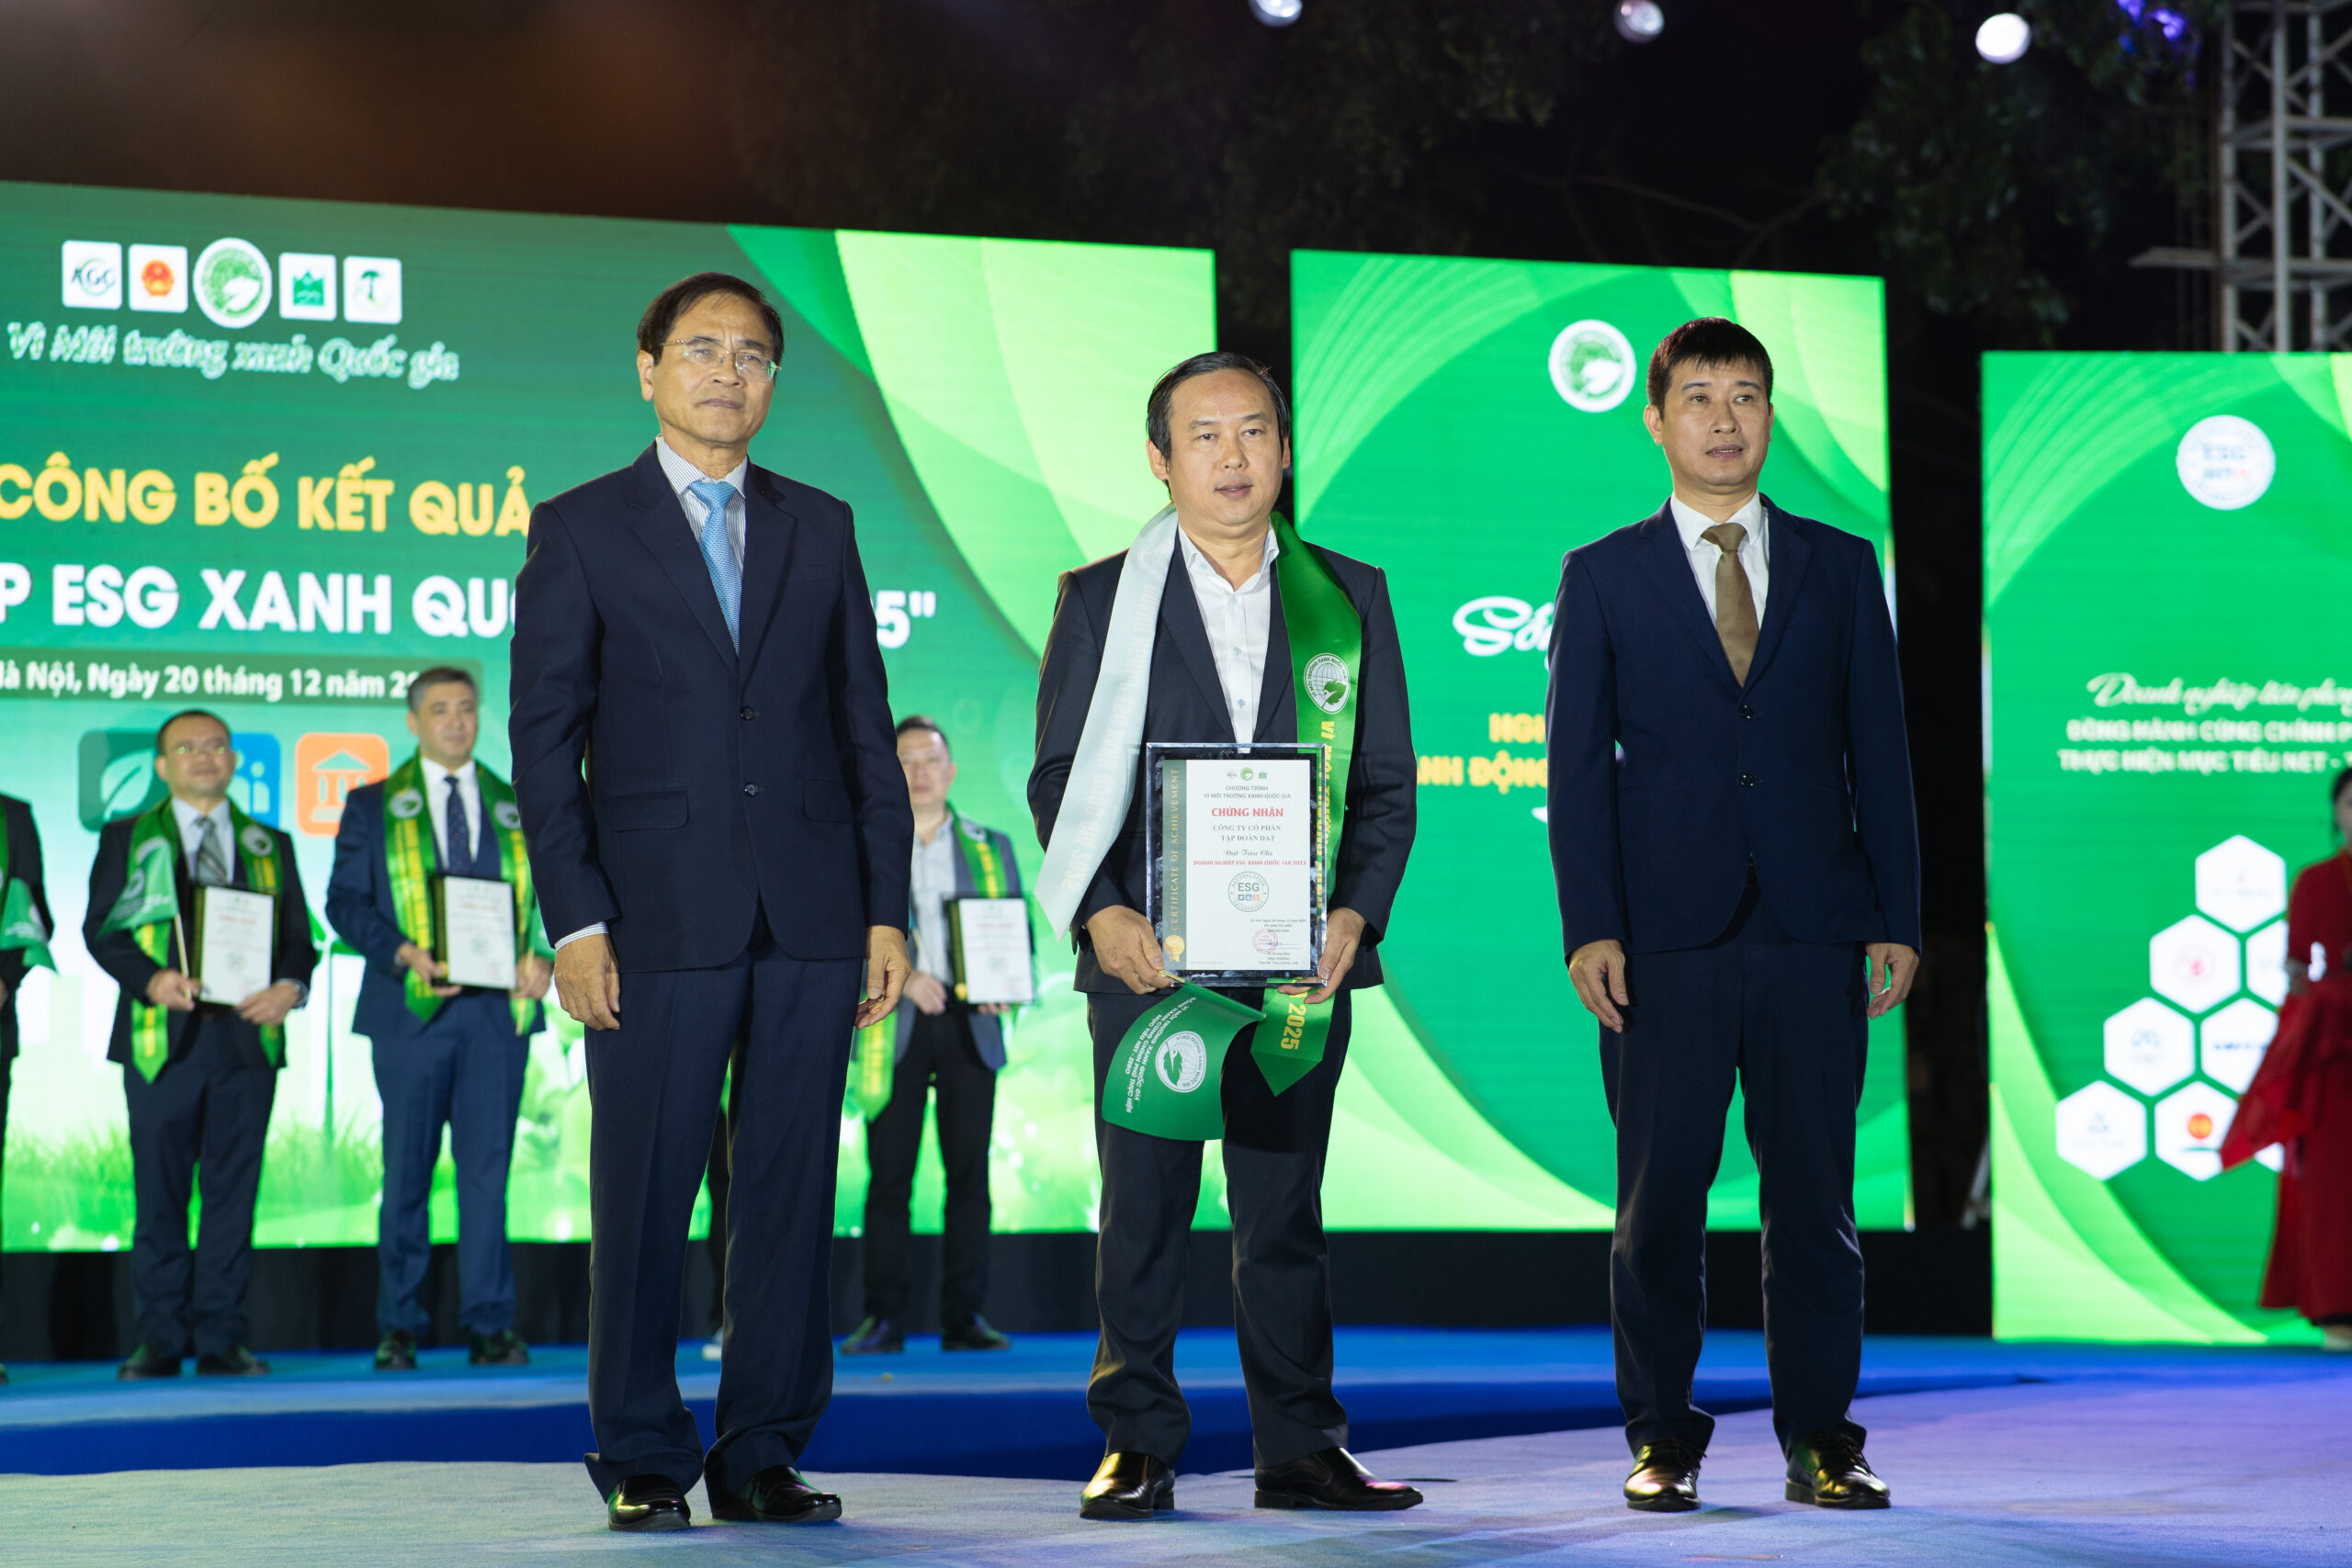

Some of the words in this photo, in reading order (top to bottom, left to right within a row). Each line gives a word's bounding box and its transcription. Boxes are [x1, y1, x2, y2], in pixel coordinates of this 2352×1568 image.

[318, 333, 407, 383] Quốc
[0, 451, 176, 525] CÔNG
[195, 452, 279, 528] BỐ
[298, 456, 394, 533] KẾT
[409, 466, 530, 536] QUẢ
[52, 564, 179, 628] ESG
[198, 570, 392, 634] XANH
[413, 575, 516, 638] QU
[0, 660, 20, 690] à
[87, 662, 158, 700] Ngày
[164, 665, 198, 694] 20
[203, 663, 282, 702] tháng
[289, 668, 322, 695] 12
[326, 670, 385, 698] năm
[1321, 721, 1335, 739] VÌ
[1170, 770, 1179, 844] ACHIEVEMENT
[1252, 806, 1283, 818] NHẬN
[1170, 850, 1179, 862] OF
[1170, 867, 1179, 931] CERTIFICATE
[1238, 882, 1260, 892] ESG
[1281, 1003, 1306, 1050] 2025
